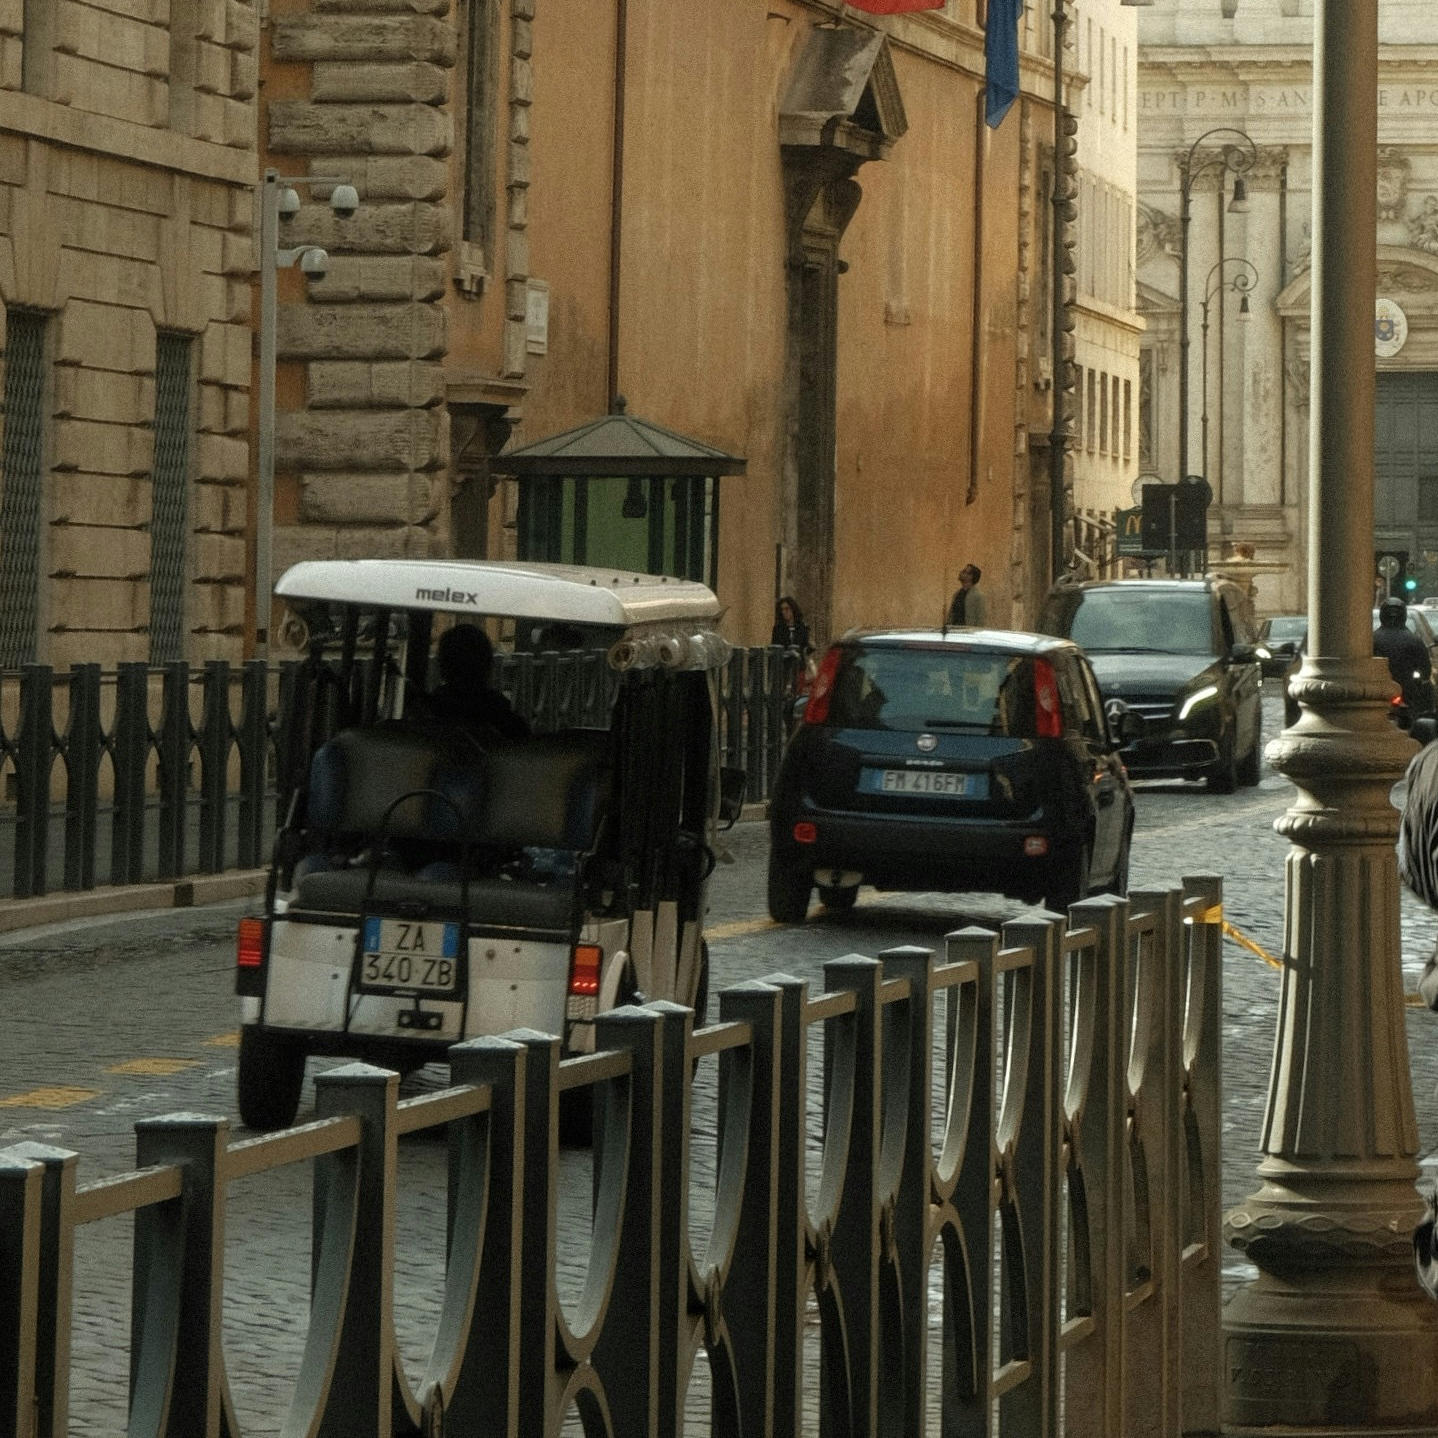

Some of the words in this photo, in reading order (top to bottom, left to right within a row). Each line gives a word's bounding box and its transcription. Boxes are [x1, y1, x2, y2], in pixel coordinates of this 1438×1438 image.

[415, 587, 479, 605] melex
[396, 923, 425, 952] ZA
[366, 954, 412, 984] 340
[421, 958, 452, 986] ZB
